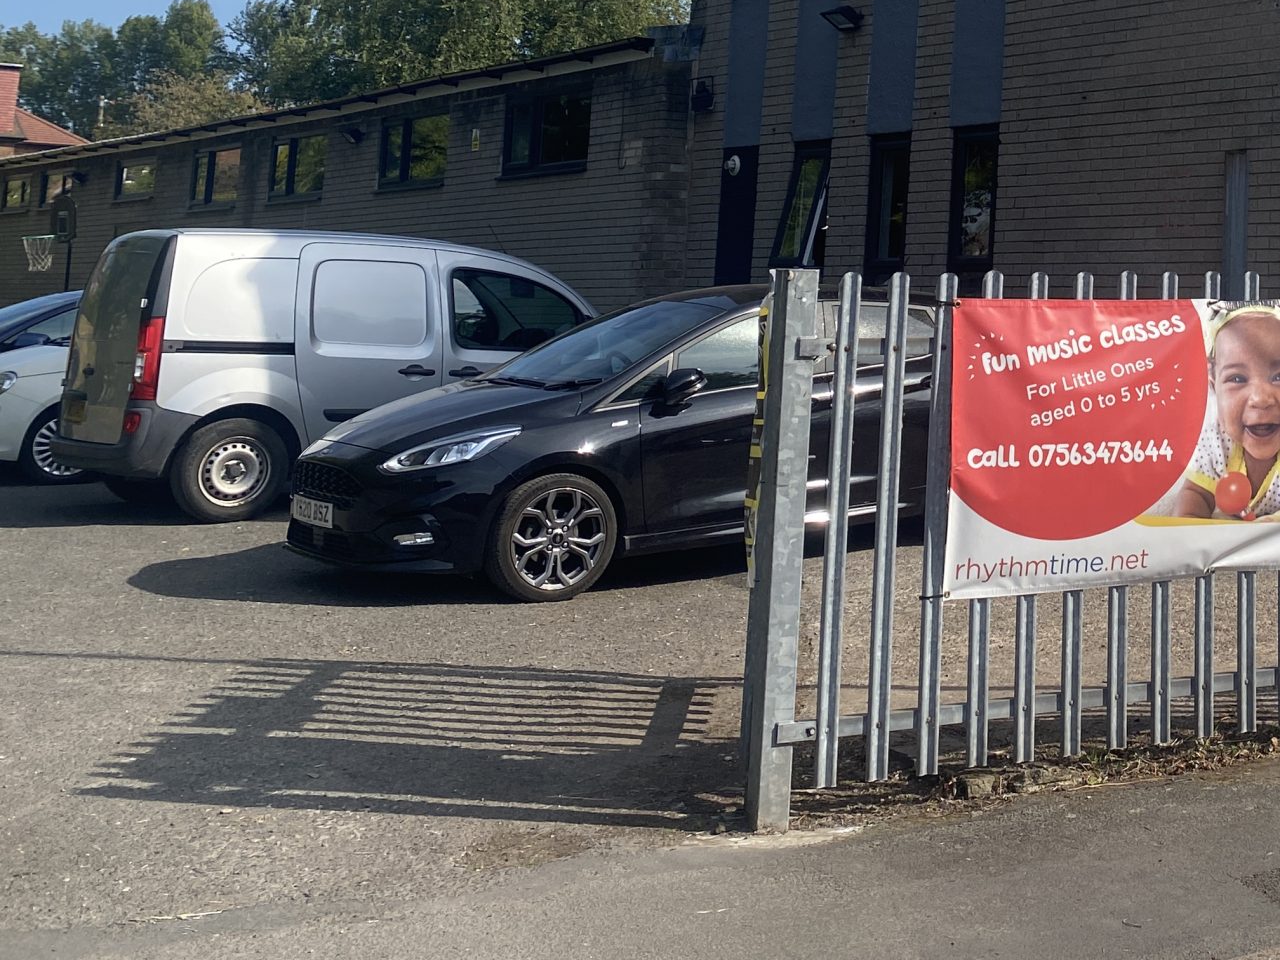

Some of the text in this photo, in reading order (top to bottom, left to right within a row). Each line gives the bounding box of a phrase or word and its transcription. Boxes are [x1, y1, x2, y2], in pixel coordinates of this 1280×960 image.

[982, 352, 1020, 375] fun
[1100, 314, 1186, 348] classes
[1026, 356, 1154, 400] For Little Ones
[1030, 381, 1160, 426] aged 0 to 5 yrs
[1028, 439, 1174, 468] 07563473644
[955, 549, 1149, 582] rhythmtime.net
